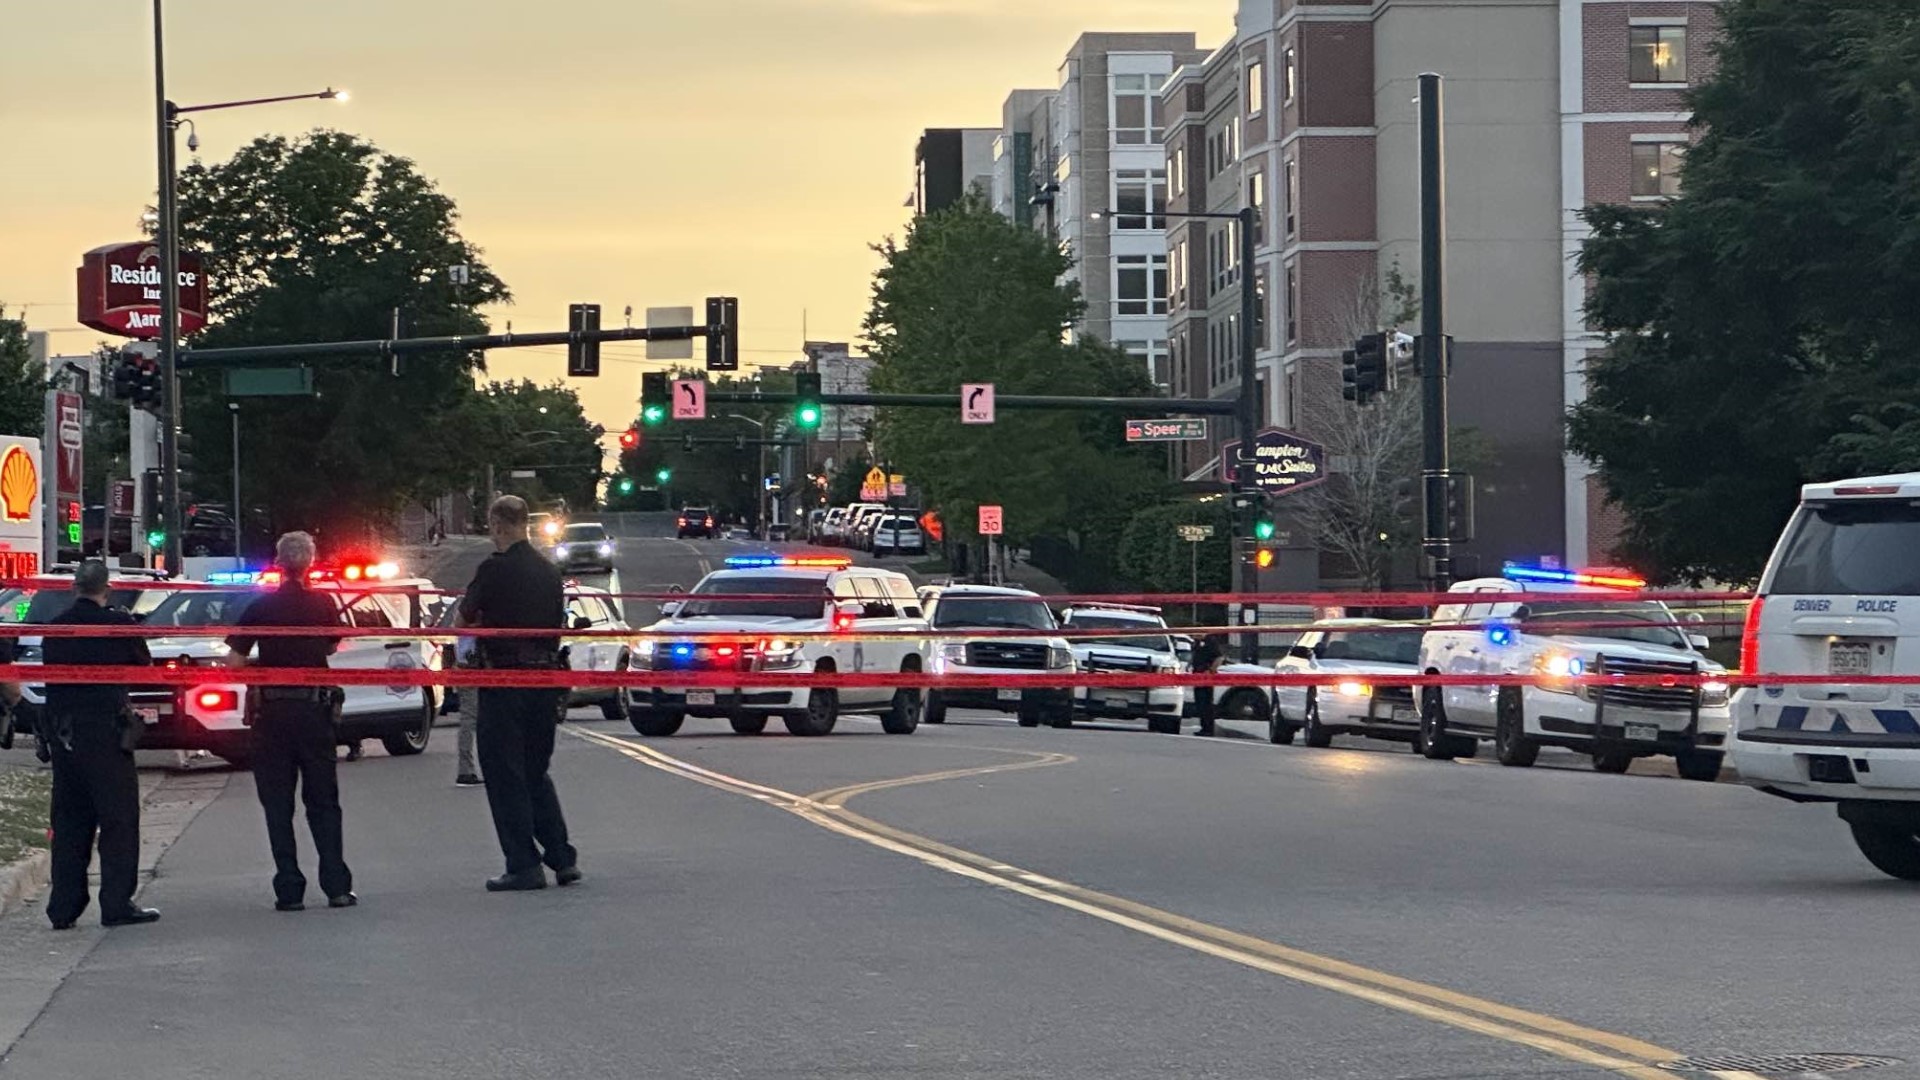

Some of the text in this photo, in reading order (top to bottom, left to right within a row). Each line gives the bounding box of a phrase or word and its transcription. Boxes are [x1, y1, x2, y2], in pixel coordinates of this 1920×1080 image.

[110, 264, 196, 287] Residce
[679, 407, 699, 416] ONLY
[968, 411, 988, 420] ONLY
[1144, 423, 1182, 437] Speer
[1245, 443, 1309, 459] ampton
[983, 521, 999, 531] 30
[1794, 600, 1898, 613] DENVER POLICE
